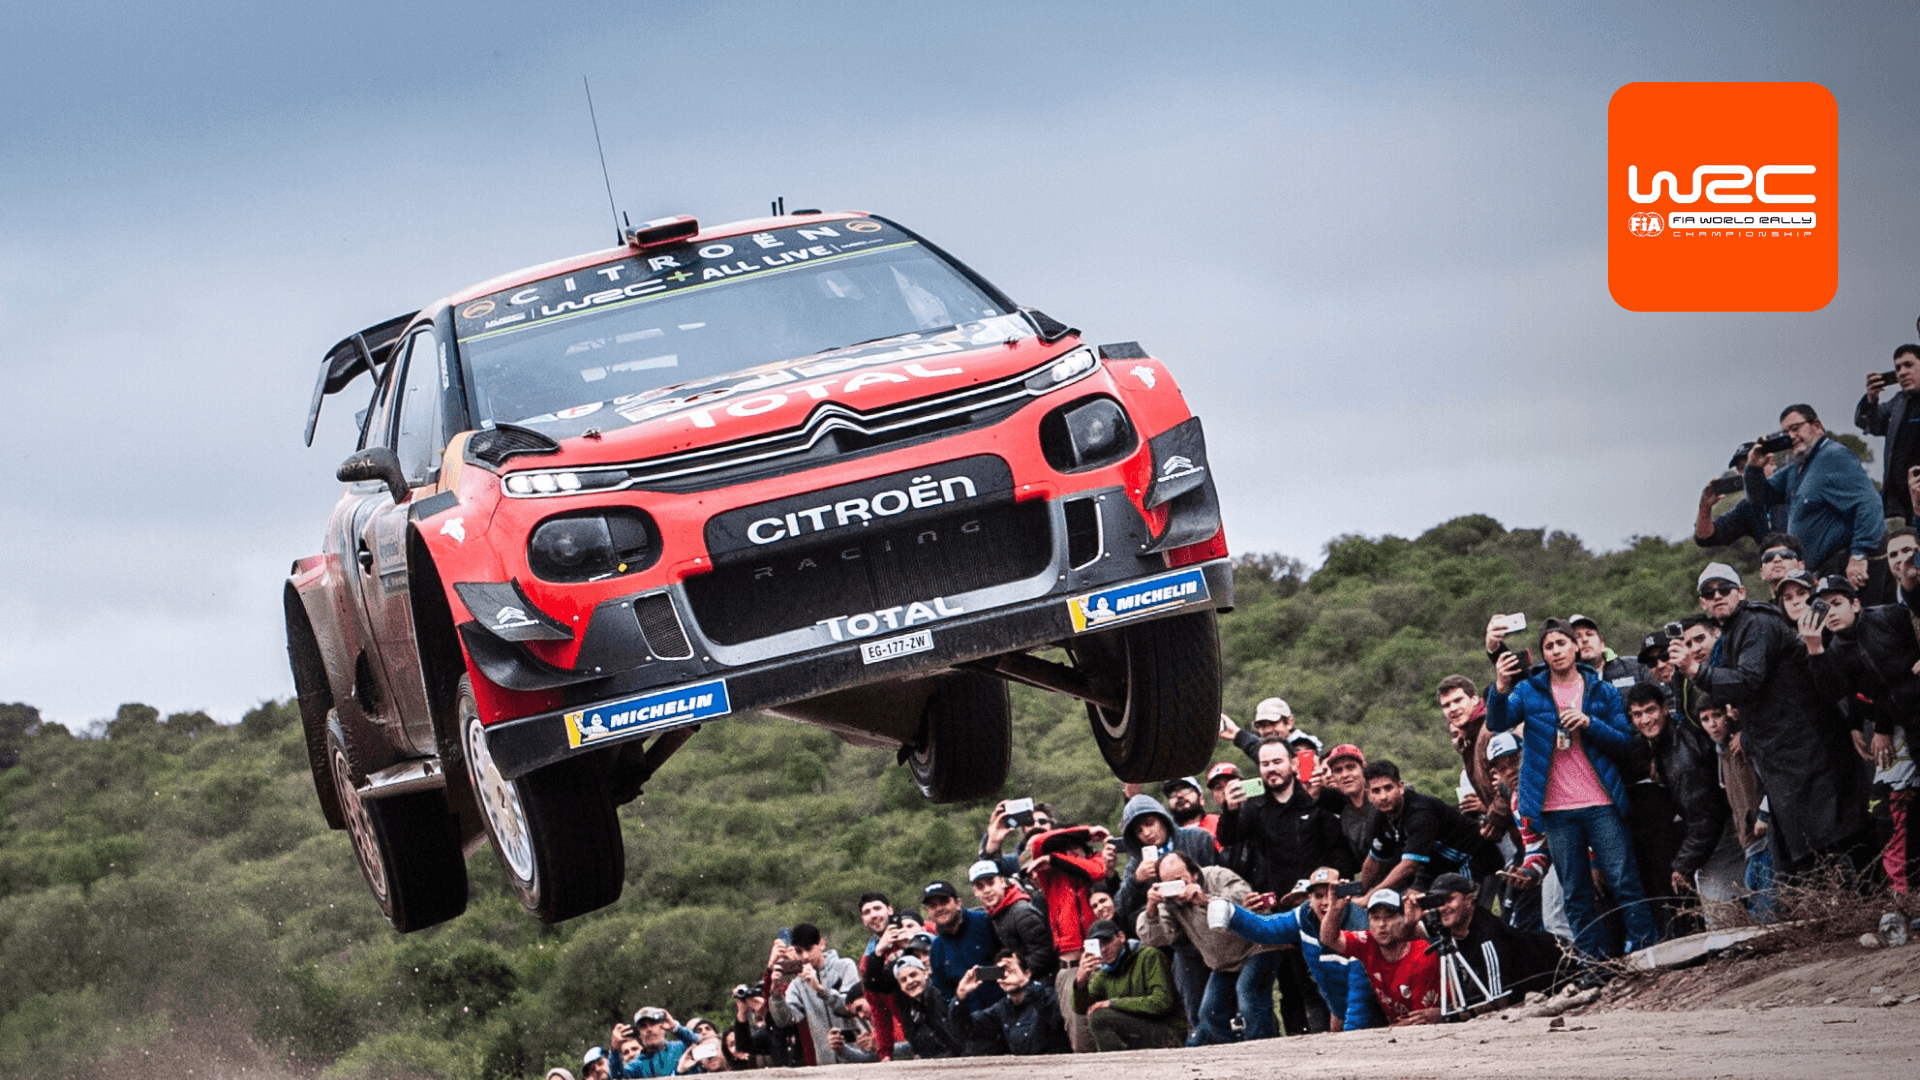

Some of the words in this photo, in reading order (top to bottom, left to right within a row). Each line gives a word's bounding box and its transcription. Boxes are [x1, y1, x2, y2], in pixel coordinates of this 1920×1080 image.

[510, 226, 841, 305] CITROËN
[703, 260, 760, 280] ALL
[762, 243, 833, 266] LIVE
[666, 363, 964, 429] TOTAL
[747, 475, 977, 545] CITROËN
[754, 519, 981, 580] RACING
[1115, 580, 1198, 612] MICHELIN
[816, 597, 964, 642] TOTAL
[868, 634, 926, 659] EG-177-ZW
[609, 693, 713, 729] MICHELIN
